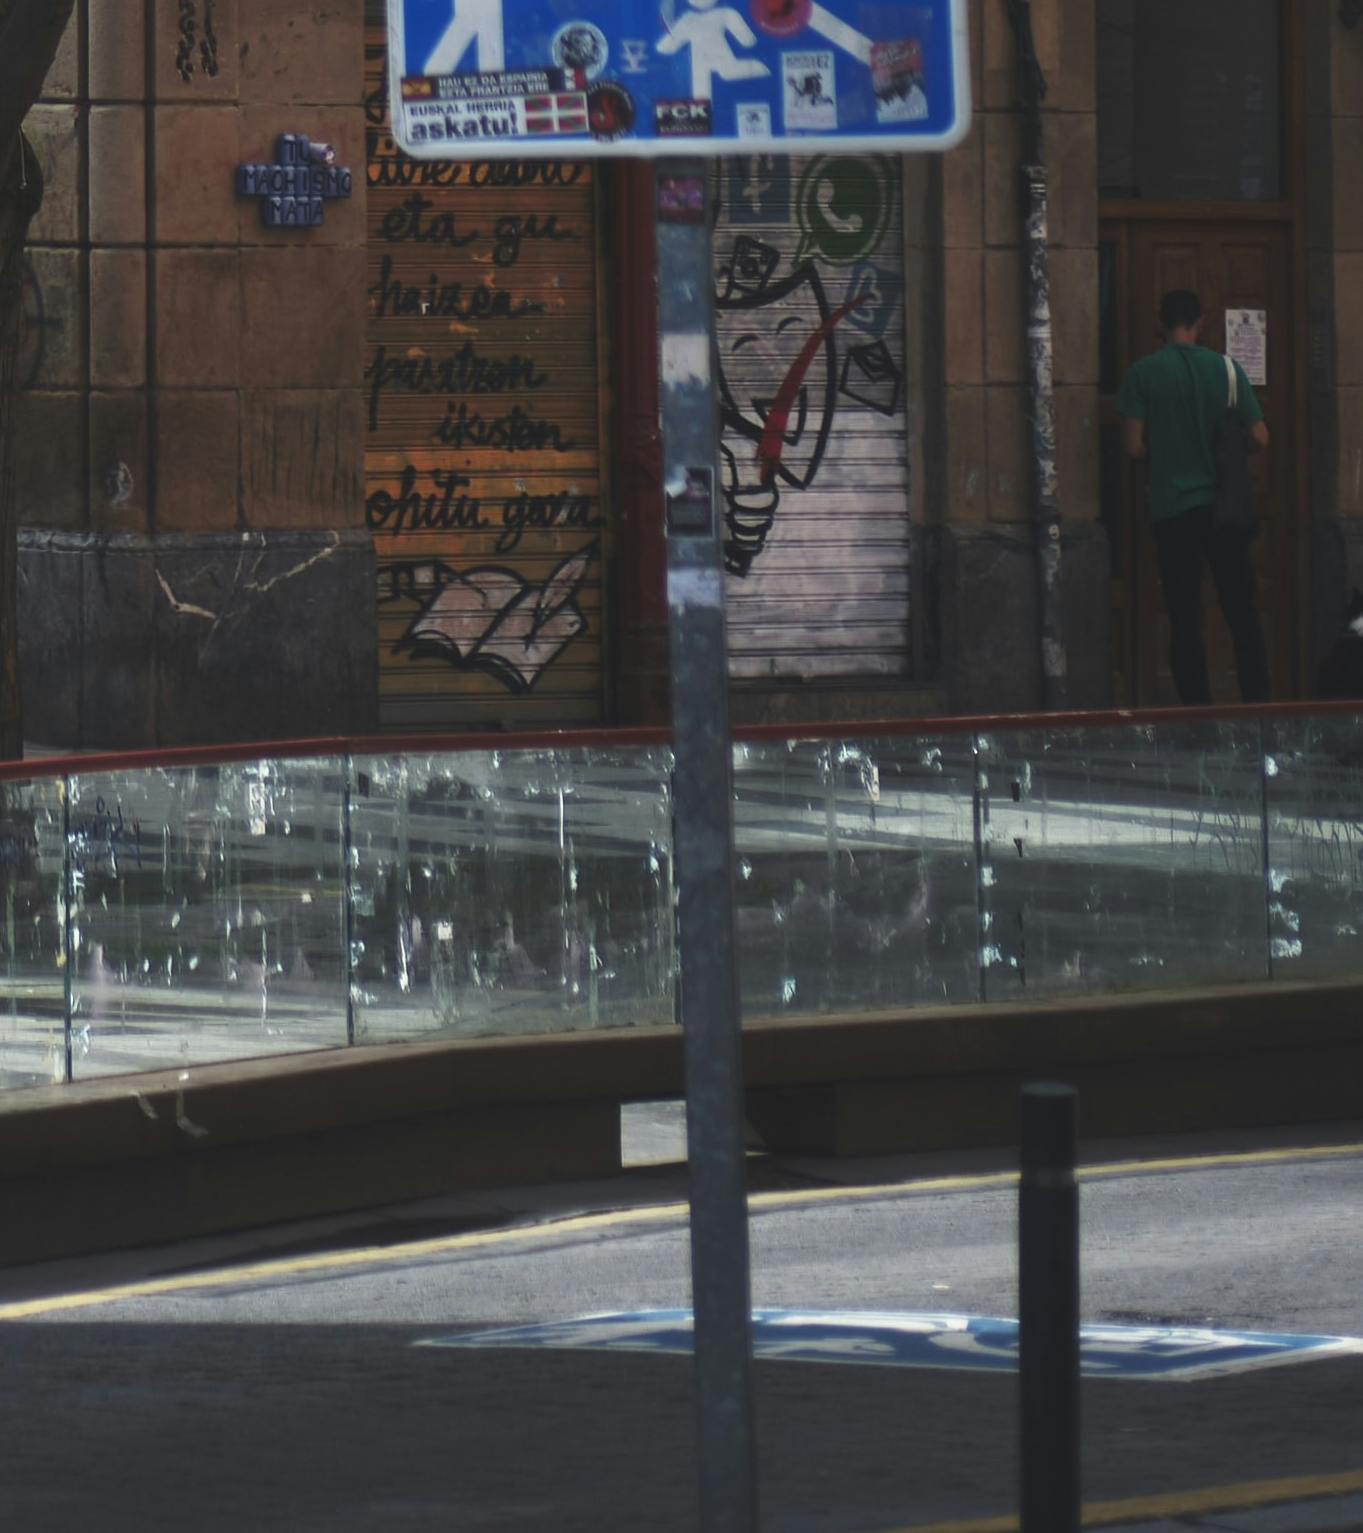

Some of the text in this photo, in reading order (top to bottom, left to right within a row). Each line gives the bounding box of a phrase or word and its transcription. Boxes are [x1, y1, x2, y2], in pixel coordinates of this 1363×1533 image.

[410, 100, 516, 116] EUSKAL HERRIA
[411, 112, 518, 139] askatu!
[242, 168, 351, 193] MACHISMO
[271, 199, 323, 223] MATA
[377, 191, 577, 267] eta gu
